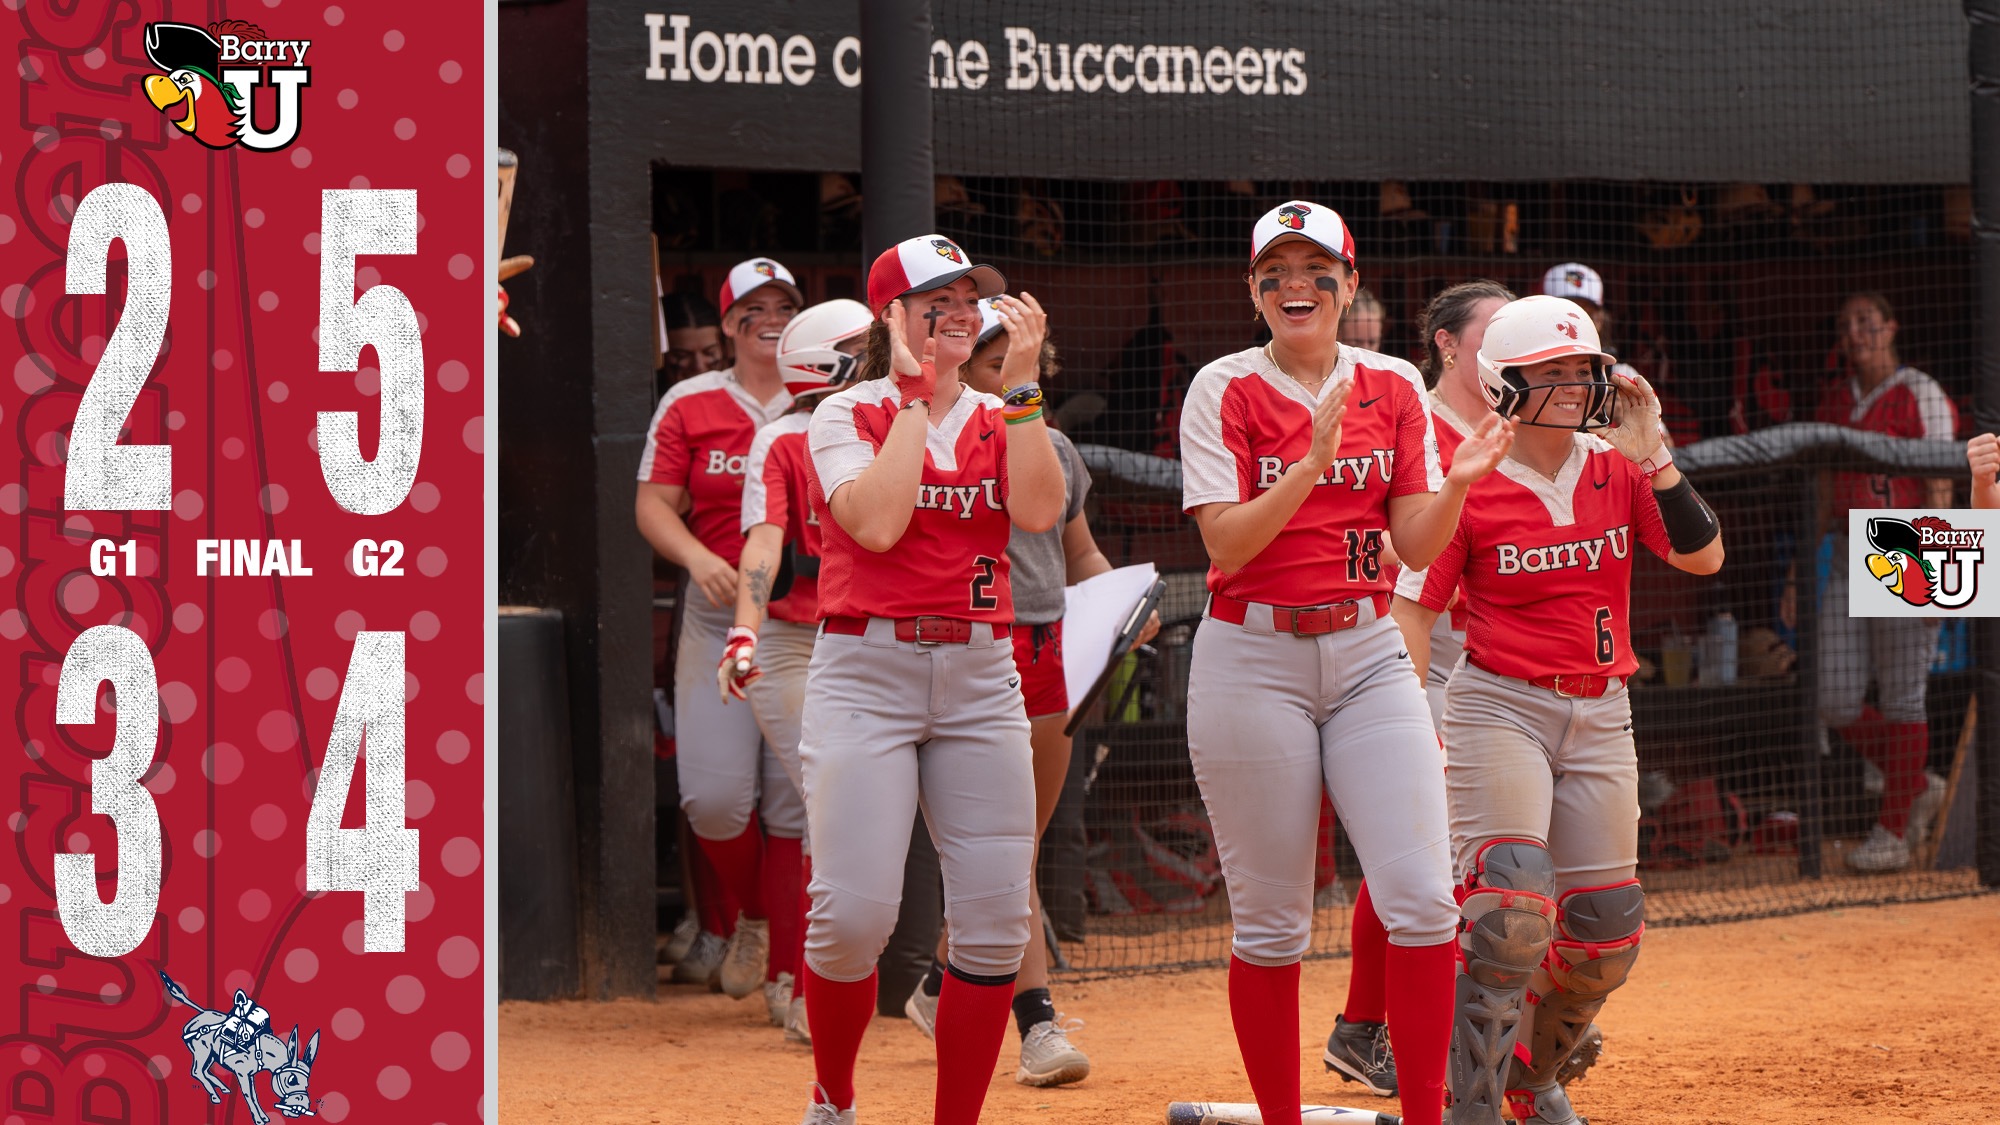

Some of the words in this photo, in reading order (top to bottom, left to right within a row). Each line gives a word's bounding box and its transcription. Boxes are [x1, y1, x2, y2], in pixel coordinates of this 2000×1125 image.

[644, 13, 817, 86] Home
[832, 36, 861, 88] o
[1004, 26, 1308, 96] Buccaneers
[969, 554, 999, 611] 2
[1343, 528, 1383, 582] 18
[1593, 605, 1615, 666] 6
